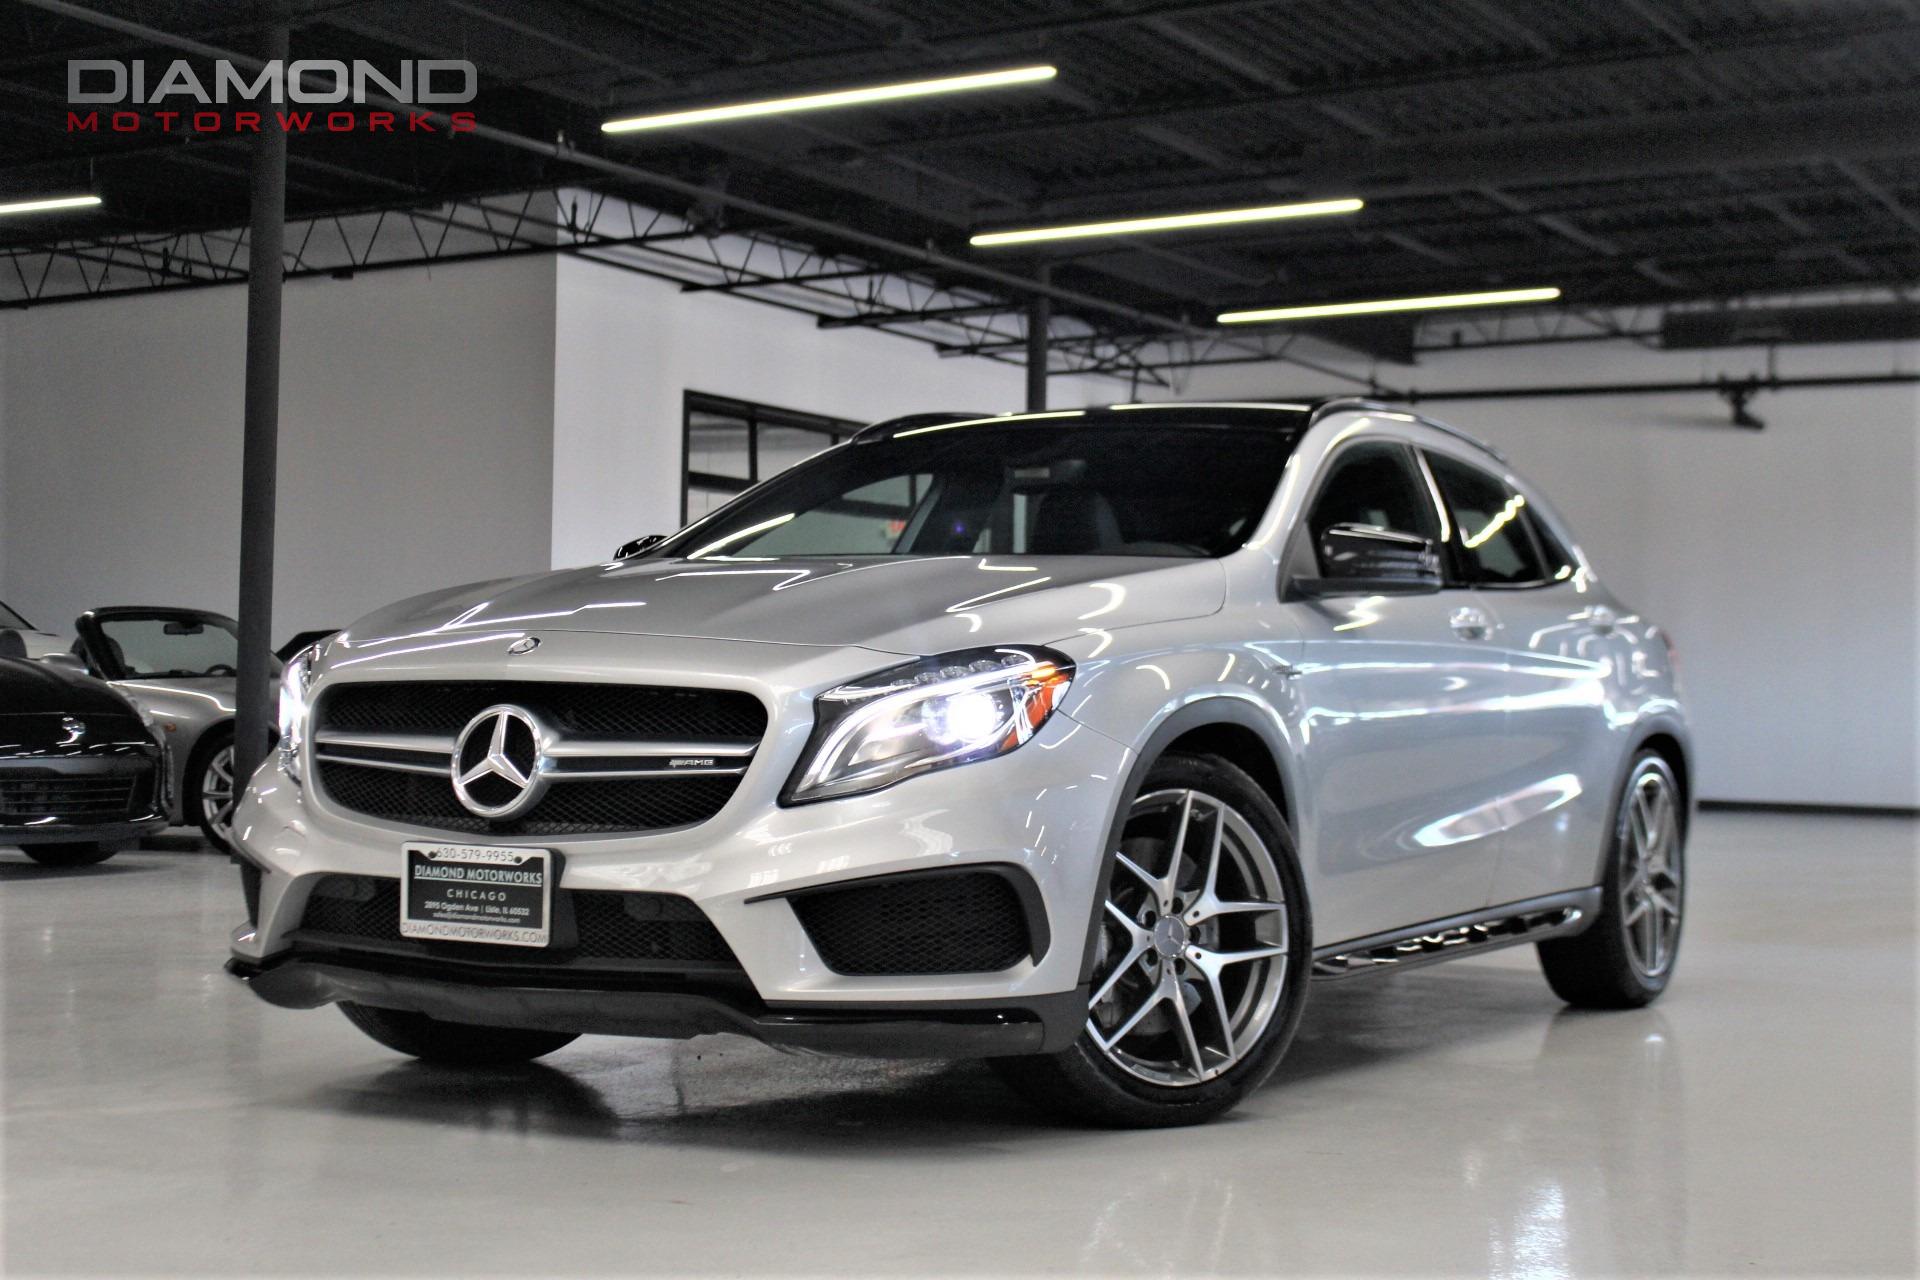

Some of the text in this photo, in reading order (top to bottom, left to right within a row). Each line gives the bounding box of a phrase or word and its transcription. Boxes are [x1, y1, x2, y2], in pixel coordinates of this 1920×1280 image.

[436, 847, 514, 862] 630-579-9955
[414, 865, 543, 884] DIAMOND MOTORWORKS
[446, 888, 507, 901] CHICAGO
[441, 902, 465, 912] Ogden
[465, 904, 479, 912] Ave
[402, 922, 547, 943] DIAMONDMOTORWORKS.COM
